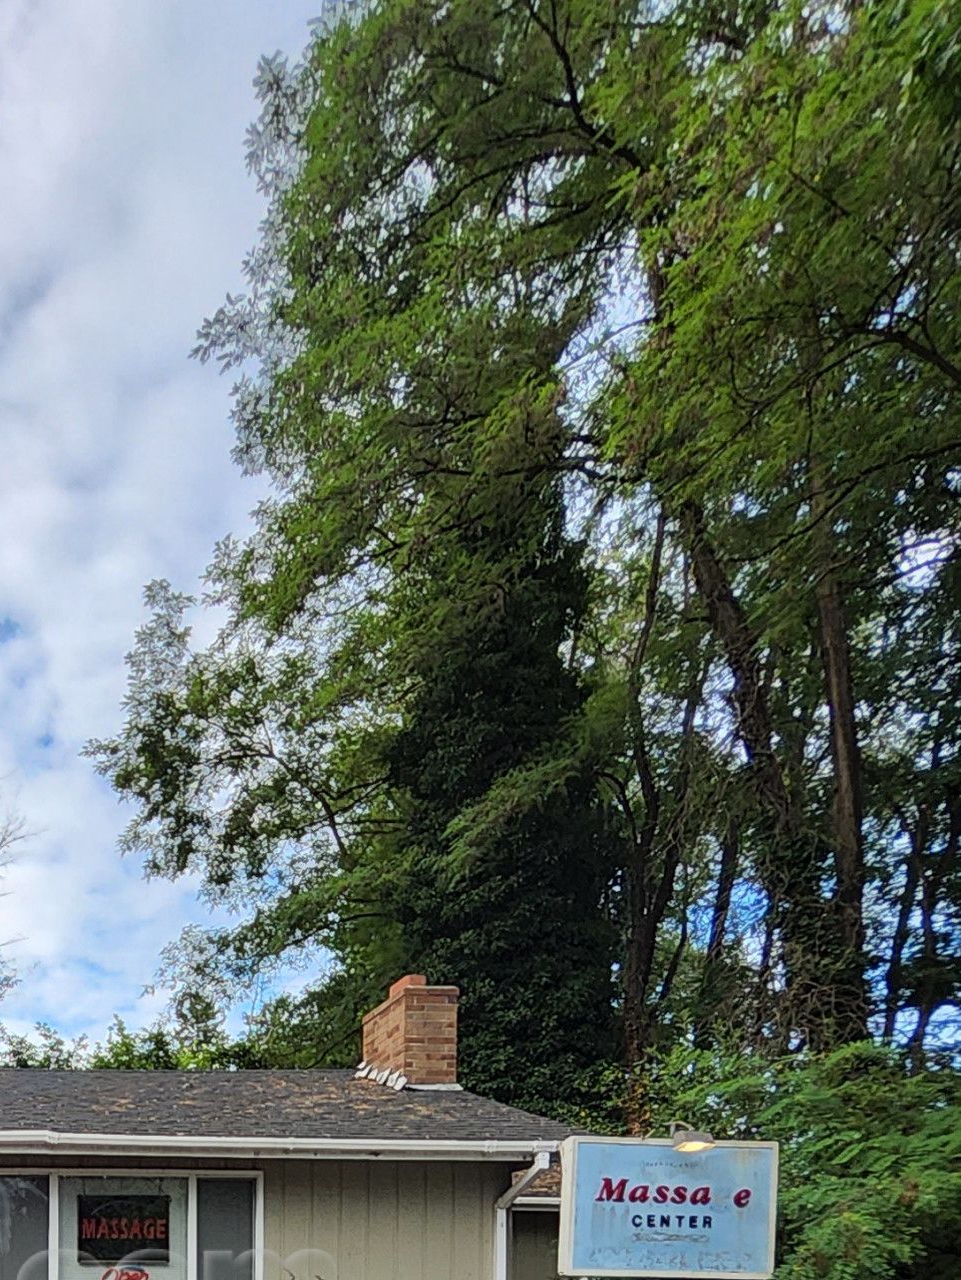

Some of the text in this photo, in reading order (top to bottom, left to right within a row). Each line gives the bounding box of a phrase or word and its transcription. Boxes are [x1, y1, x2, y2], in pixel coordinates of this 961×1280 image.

[595, 1177, 752, 1208] Massae
[82, 1217, 167, 1239] MASSAGE
[631, 1215, 713, 1228] CENTER
